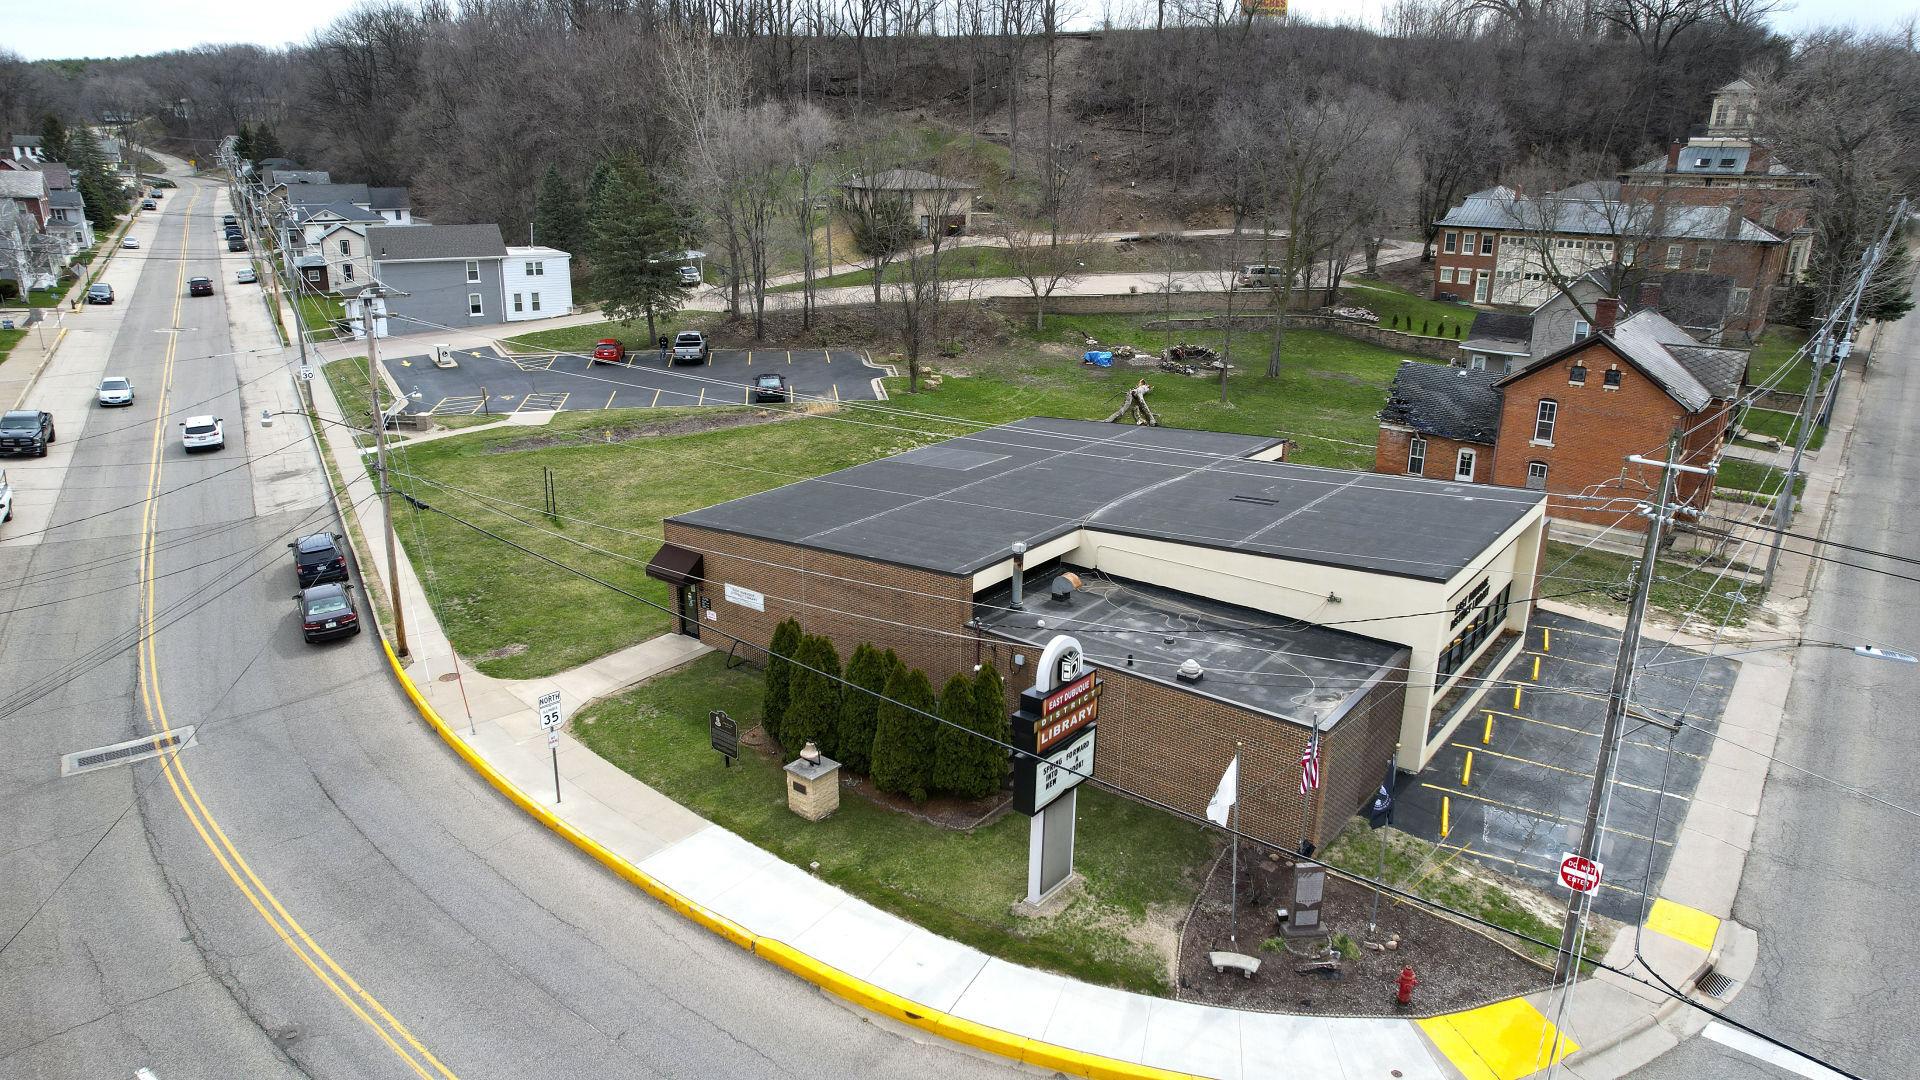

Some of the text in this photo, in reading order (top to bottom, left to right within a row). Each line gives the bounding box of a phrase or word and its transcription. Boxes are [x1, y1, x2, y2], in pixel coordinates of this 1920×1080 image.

[539, 693, 560, 705] NORTH
[1048, 680, 1090, 711] EAST DUBUQUE
[1041, 689, 1096, 727] DISTRICT
[543, 711, 559, 725] 35
[1041, 704, 1094, 744] LIBRARY
[1043, 740, 1090, 776] SPRING FORWARD
[1045, 769, 1059, 783] INTO
[1045, 777, 1057, 791] NEW
[1568, 860, 1595, 874] DO NOT
[1567, 874, 1590, 887] ENTER
